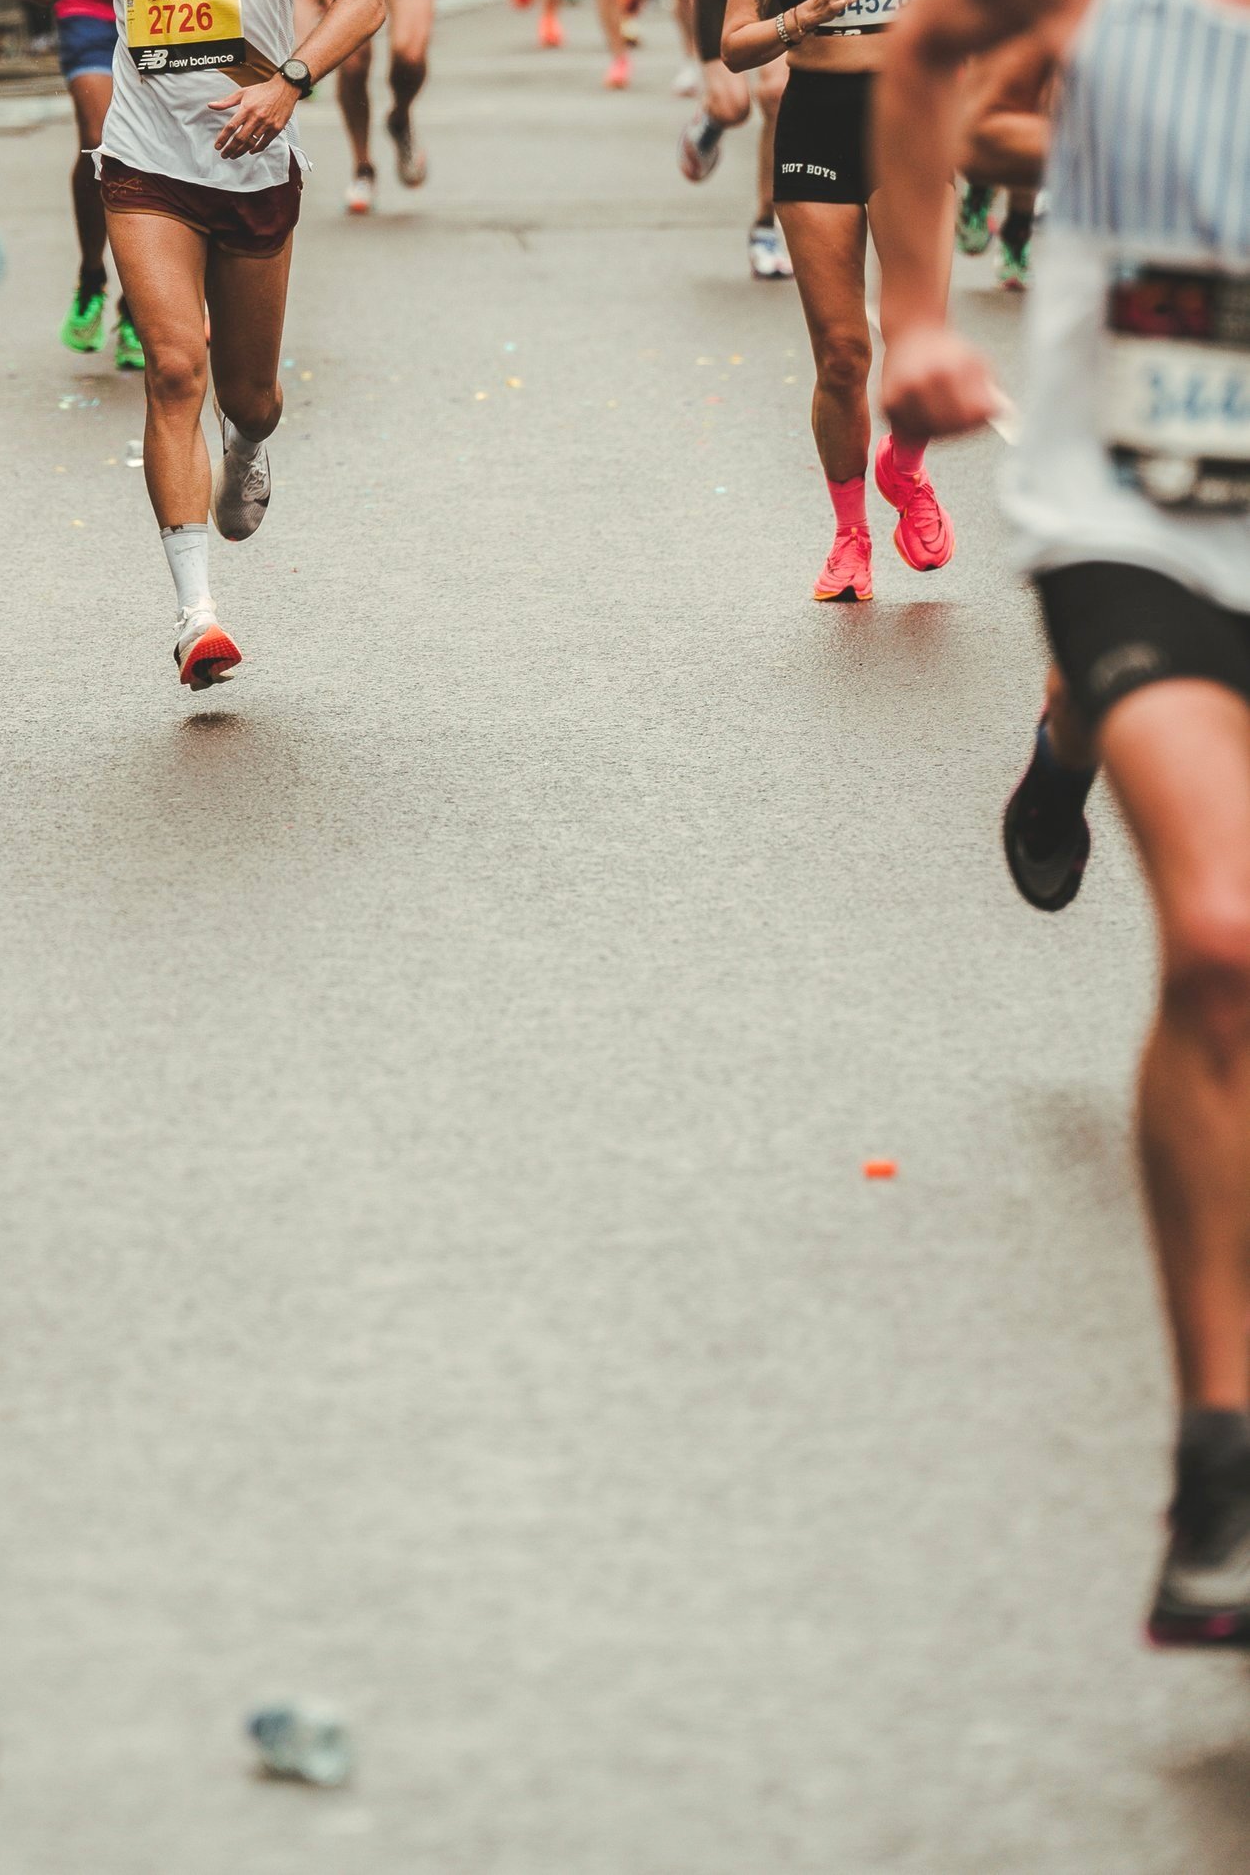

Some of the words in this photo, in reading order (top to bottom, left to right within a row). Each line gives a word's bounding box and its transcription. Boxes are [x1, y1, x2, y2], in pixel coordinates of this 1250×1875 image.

[148, 2, 213, 35] 2726
[169, 58, 189, 68] new
[189, 54, 234, 67] balance
[781, 162, 803, 174] HOT
[806, 163, 837, 181] BOYS
